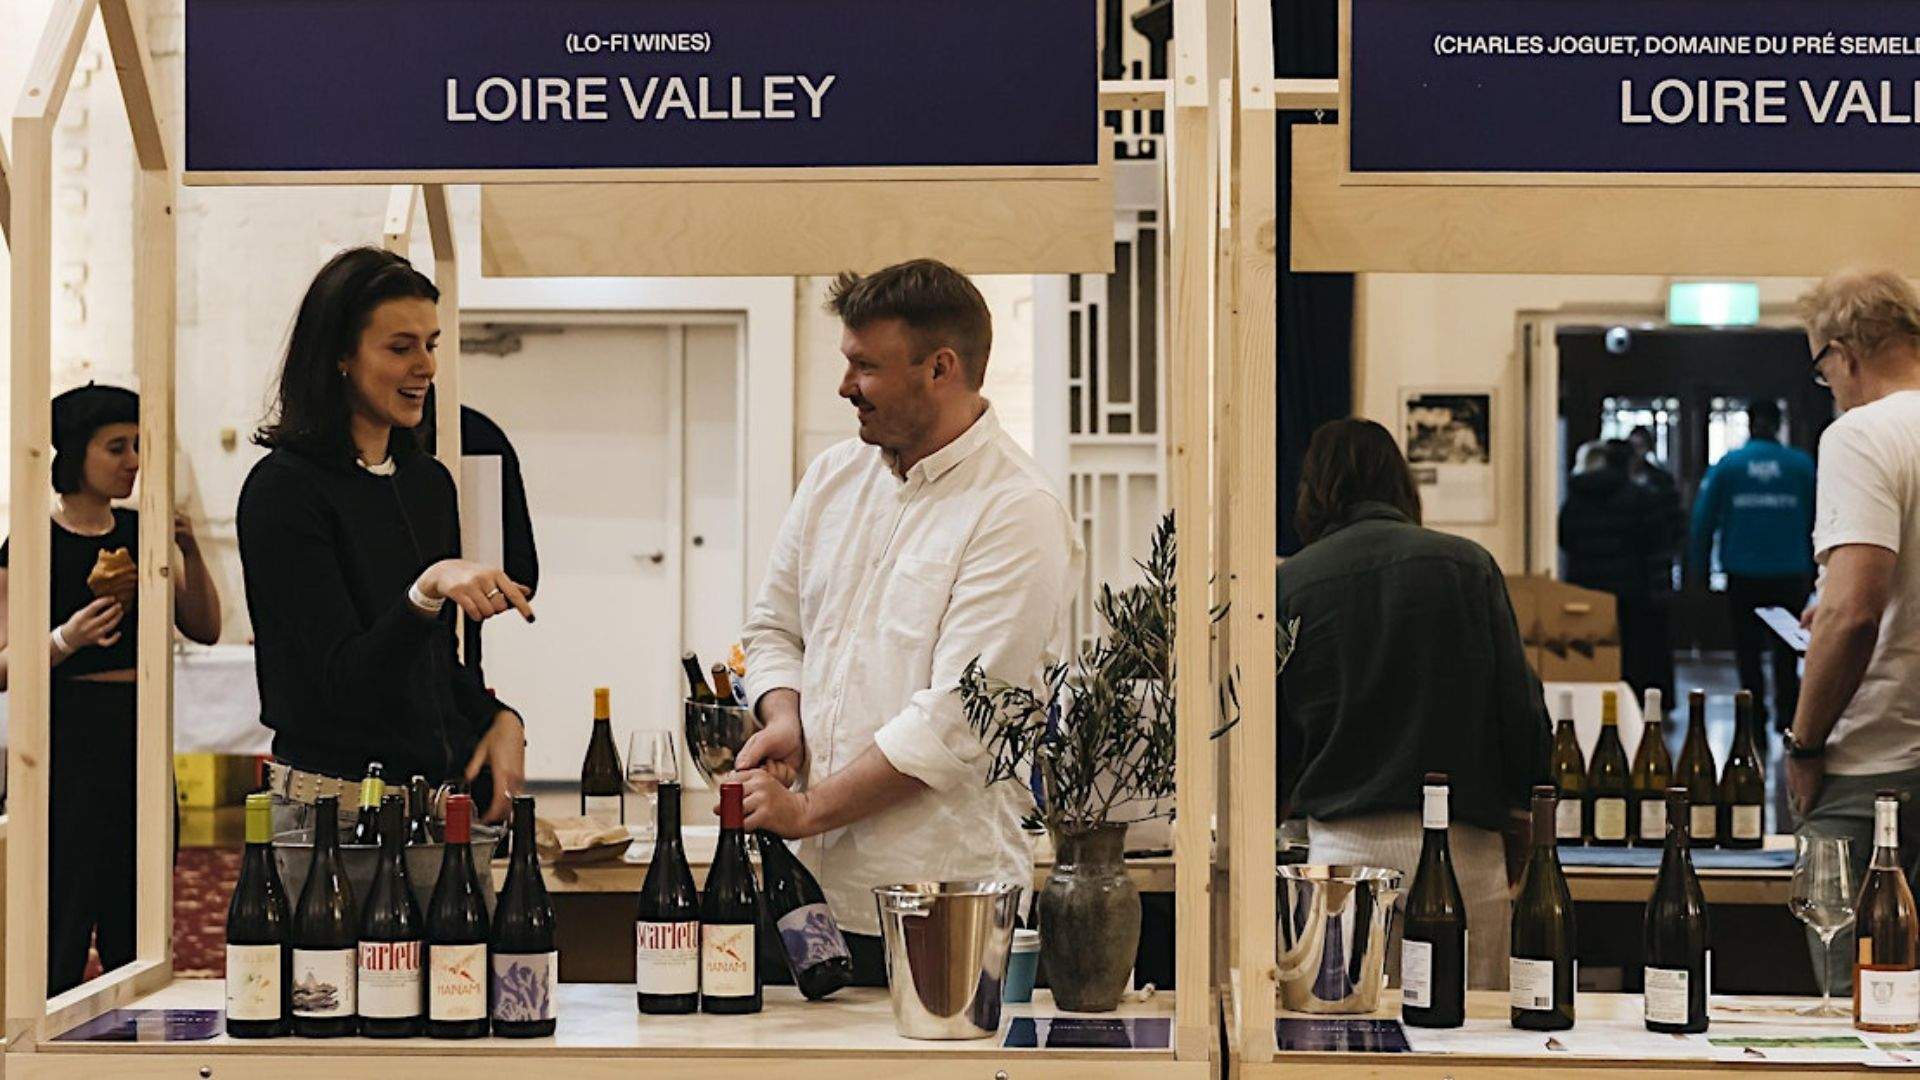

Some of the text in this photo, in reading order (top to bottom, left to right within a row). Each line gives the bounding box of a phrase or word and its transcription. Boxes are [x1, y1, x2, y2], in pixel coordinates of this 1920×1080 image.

[566, 32, 711, 54] (LO-FI WINES)
[1434, 34, 1544, 56] (CHARLES
[1548, 35, 1640, 58] JOGUET,
[1645, 35, 1751, 54] DOMAINE
[1755, 36, 1788, 54] DU
[1793, 31, 1836, 54] PRÉ
[447, 75, 836, 122] LOIRE VALLEY
[1621, 79, 1920, 123] LOIRE VAL
